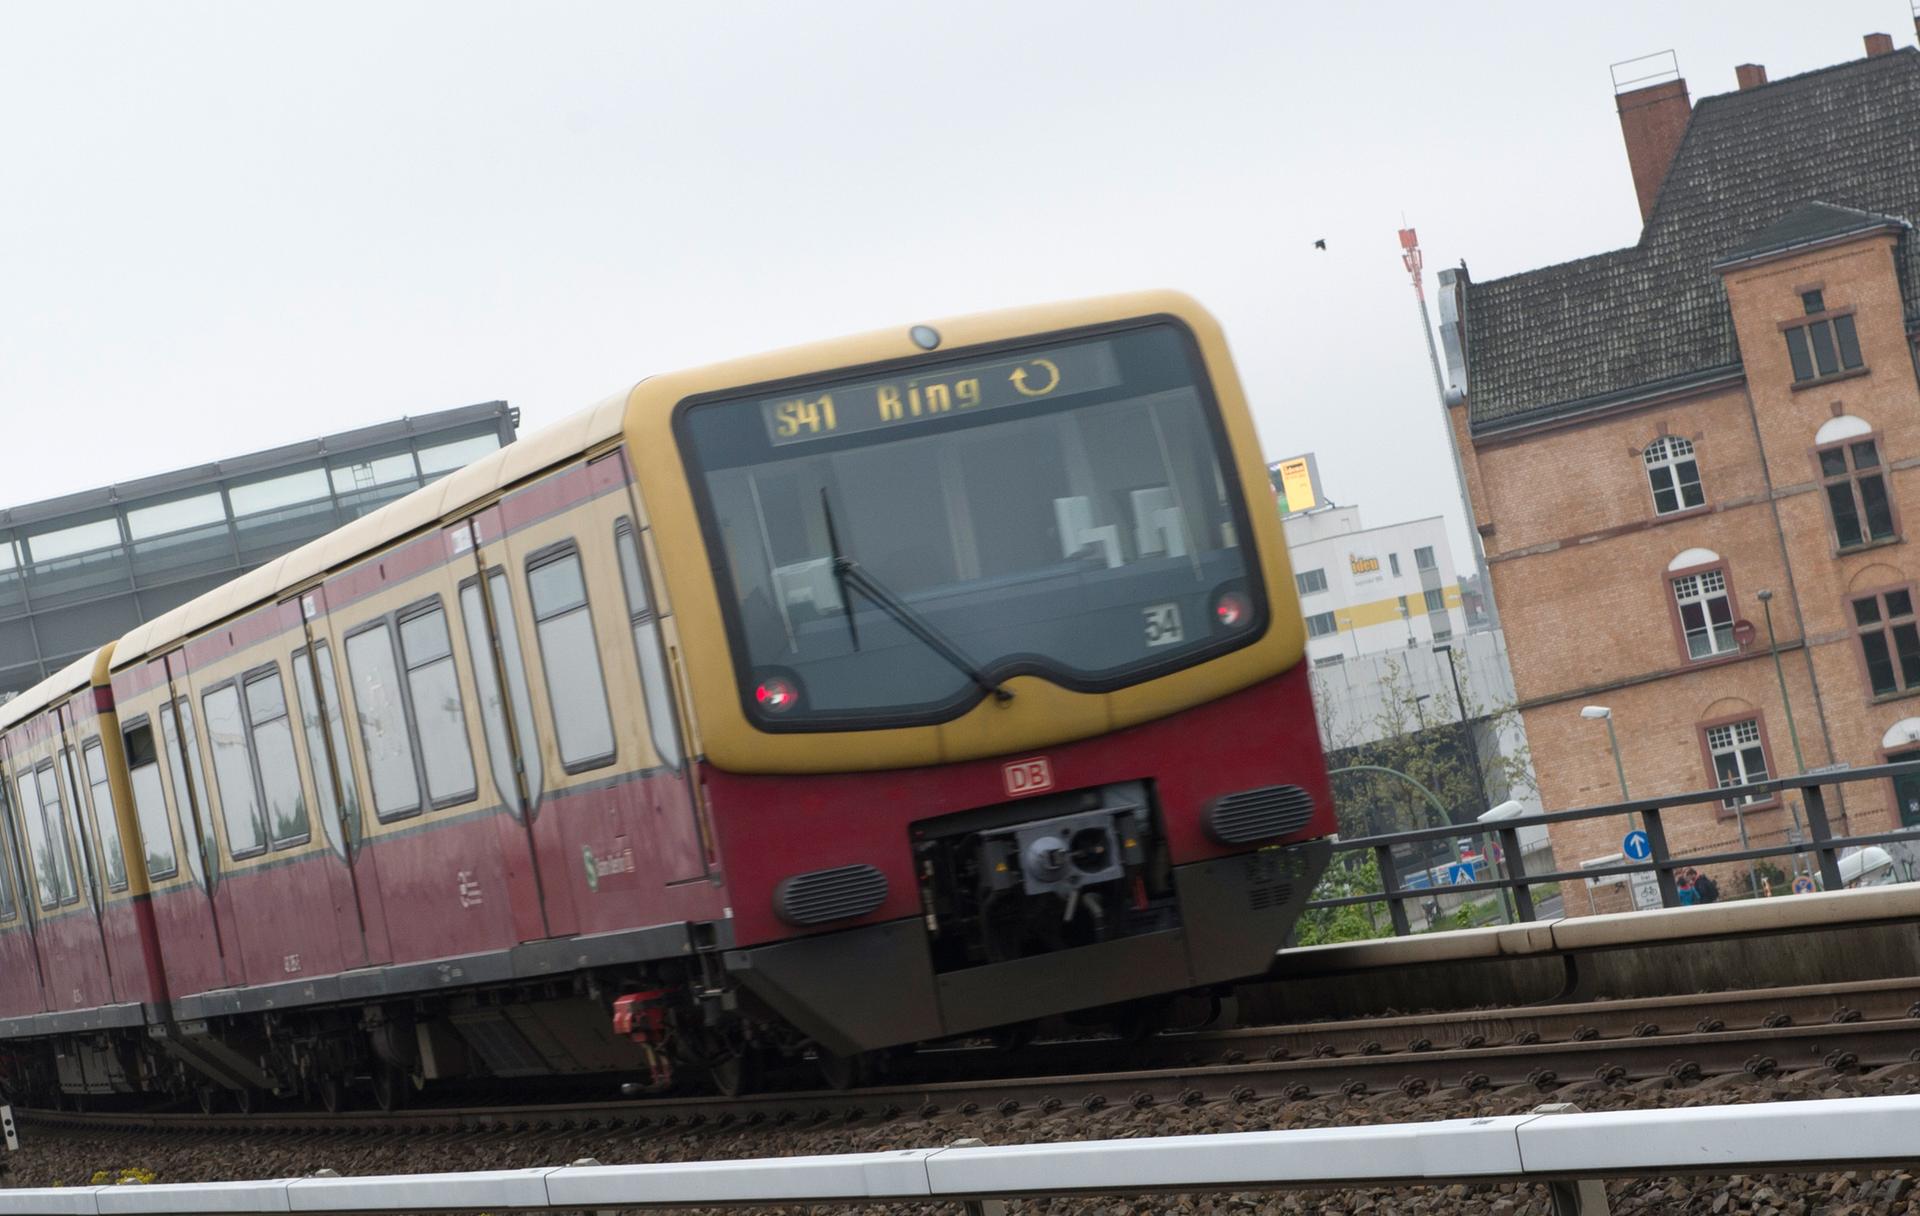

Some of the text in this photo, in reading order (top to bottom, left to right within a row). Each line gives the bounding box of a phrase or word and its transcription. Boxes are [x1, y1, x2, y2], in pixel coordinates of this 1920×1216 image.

[776, 377, 982, 437] S41 Ring
[1010, 763, 1047, 790] DB
